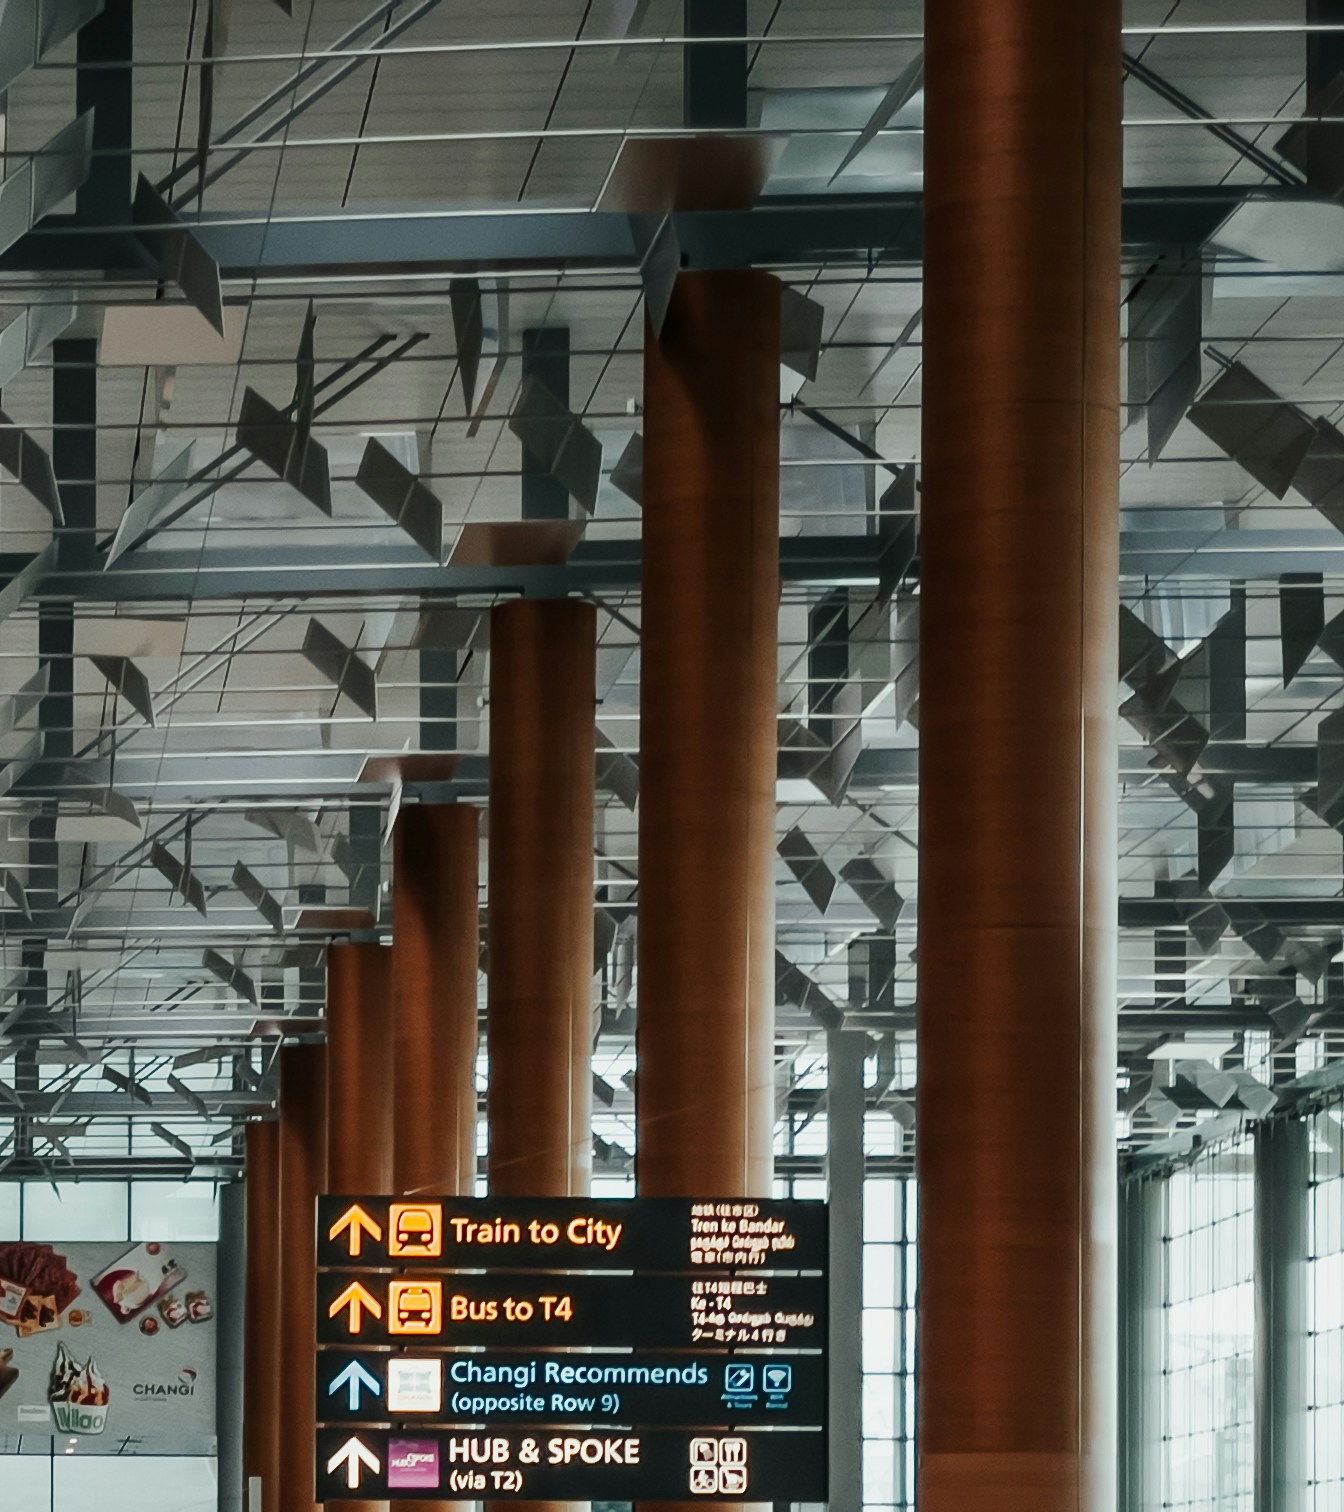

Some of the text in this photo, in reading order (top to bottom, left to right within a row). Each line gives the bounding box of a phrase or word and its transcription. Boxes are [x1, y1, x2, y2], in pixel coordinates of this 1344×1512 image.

[450, 1217, 622, 1251] Train to City
[450, 1295, 573, 1321] Bus to T4
[451, 1360, 709, 1388] Changi Recommends
[133, 1384, 194, 1396] CHANGI
[452, 1391, 620, 1415] (opposite Row 9)
[449, 1437, 640, 1465] HUB & SPOKE
[450, 1470, 523, 1492] (via T2)
